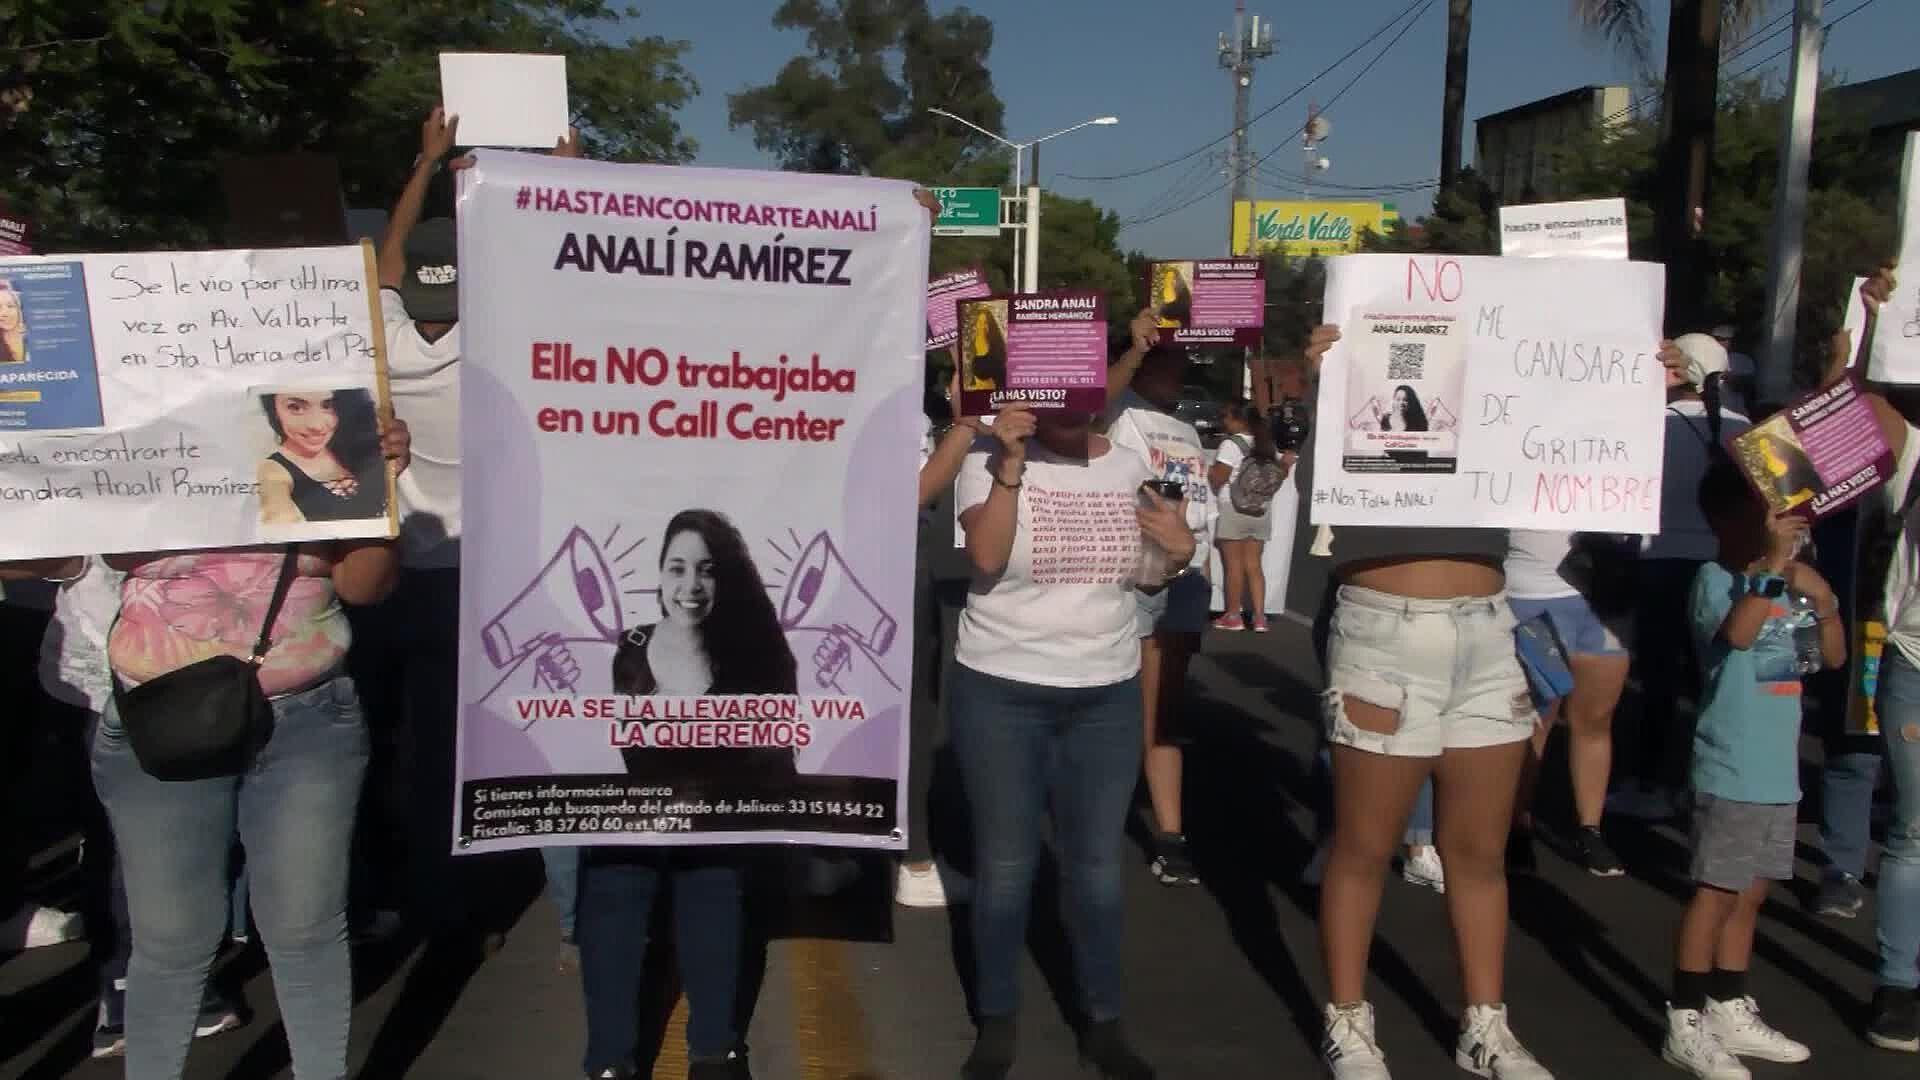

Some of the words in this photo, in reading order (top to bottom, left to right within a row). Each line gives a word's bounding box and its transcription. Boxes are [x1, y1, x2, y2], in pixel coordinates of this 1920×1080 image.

[516, 186, 877, 232] #HASTAENCONTRARTEANALÍ
[1256, 209, 1305, 241] Verde
[1308, 211, 1353, 241] Valle
[1544, 217, 1623, 230] encontrarte
[553, 227, 679, 276] ANALÍ
[686, 234, 852, 286] RAMÍREZ
[110, 265, 162, 300] Se
[171, 261, 192, 294] le
[240, 279, 284, 299] por
[1406, 257, 1464, 302] NO
[122, 319, 168, 334] vez
[177, 320, 198, 334] en
[252, 300, 348, 327] Vallarta
[1014, 299, 1059, 310] SANDRA
[1061, 296, 1096, 308] ANALÍ
[1476, 305, 1505, 340] ME
[121, 351, 147, 365] en
[293, 338, 331, 364] del
[1514, 340, 1648, 384] CANSARE
[0, 369, 79, 384] APARECIDA
[532, 343, 597, 383] Ella
[607, 347, 668, 386] NO
[677, 354, 856, 401] trabajaba
[1006, 390, 1026, 401] HAS
[1028, 389, 1067, 400] VISTO?
[1480, 393, 1520, 425] DE
[537, 406, 583, 433] en
[593, 407, 640, 435] un
[649, 401, 718, 440] Call
[727, 403, 845, 442] Center
[52, 432, 201, 464] encontrarte
[1521, 425, 1631, 464] GRITAR
[0, 478, 83, 500] andra
[1464, 471, 1513, 505] TU
[1533, 472, 1658, 514] NOMBRE
[517, 699, 575, 719] VIVA
[583, 699, 616, 719] SE
[624, 699, 656, 719] LA
[664, 698, 803, 721] LLEVARON,
[811, 700, 865, 720] VIVA
[610, 722, 646, 746] LA
[654, 722, 812, 747] QUEREMOS
[474, 788, 488, 804] Si
[490, 787, 534, 801] tienes
[537, 783, 625, 799] información
[628, 786, 673, 797] marca
[544, 802, 561, 816] de
[640, 801, 661, 814] del
[664, 801, 712, 815] estado
[715, 800, 733, 814] de
[735, 800, 785, 814] Jalisco:
[788, 800, 806, 814] 33
[809, 802, 824, 814] 15
[827, 802, 841, 815] 14
[844, 803, 861, 816] 54
[865, 804, 884, 818] 22
[535, 819, 553, 833] 38
[557, 819, 576, 832] 37
[579, 817, 599, 831] 60
[602, 817, 622, 831] 60
